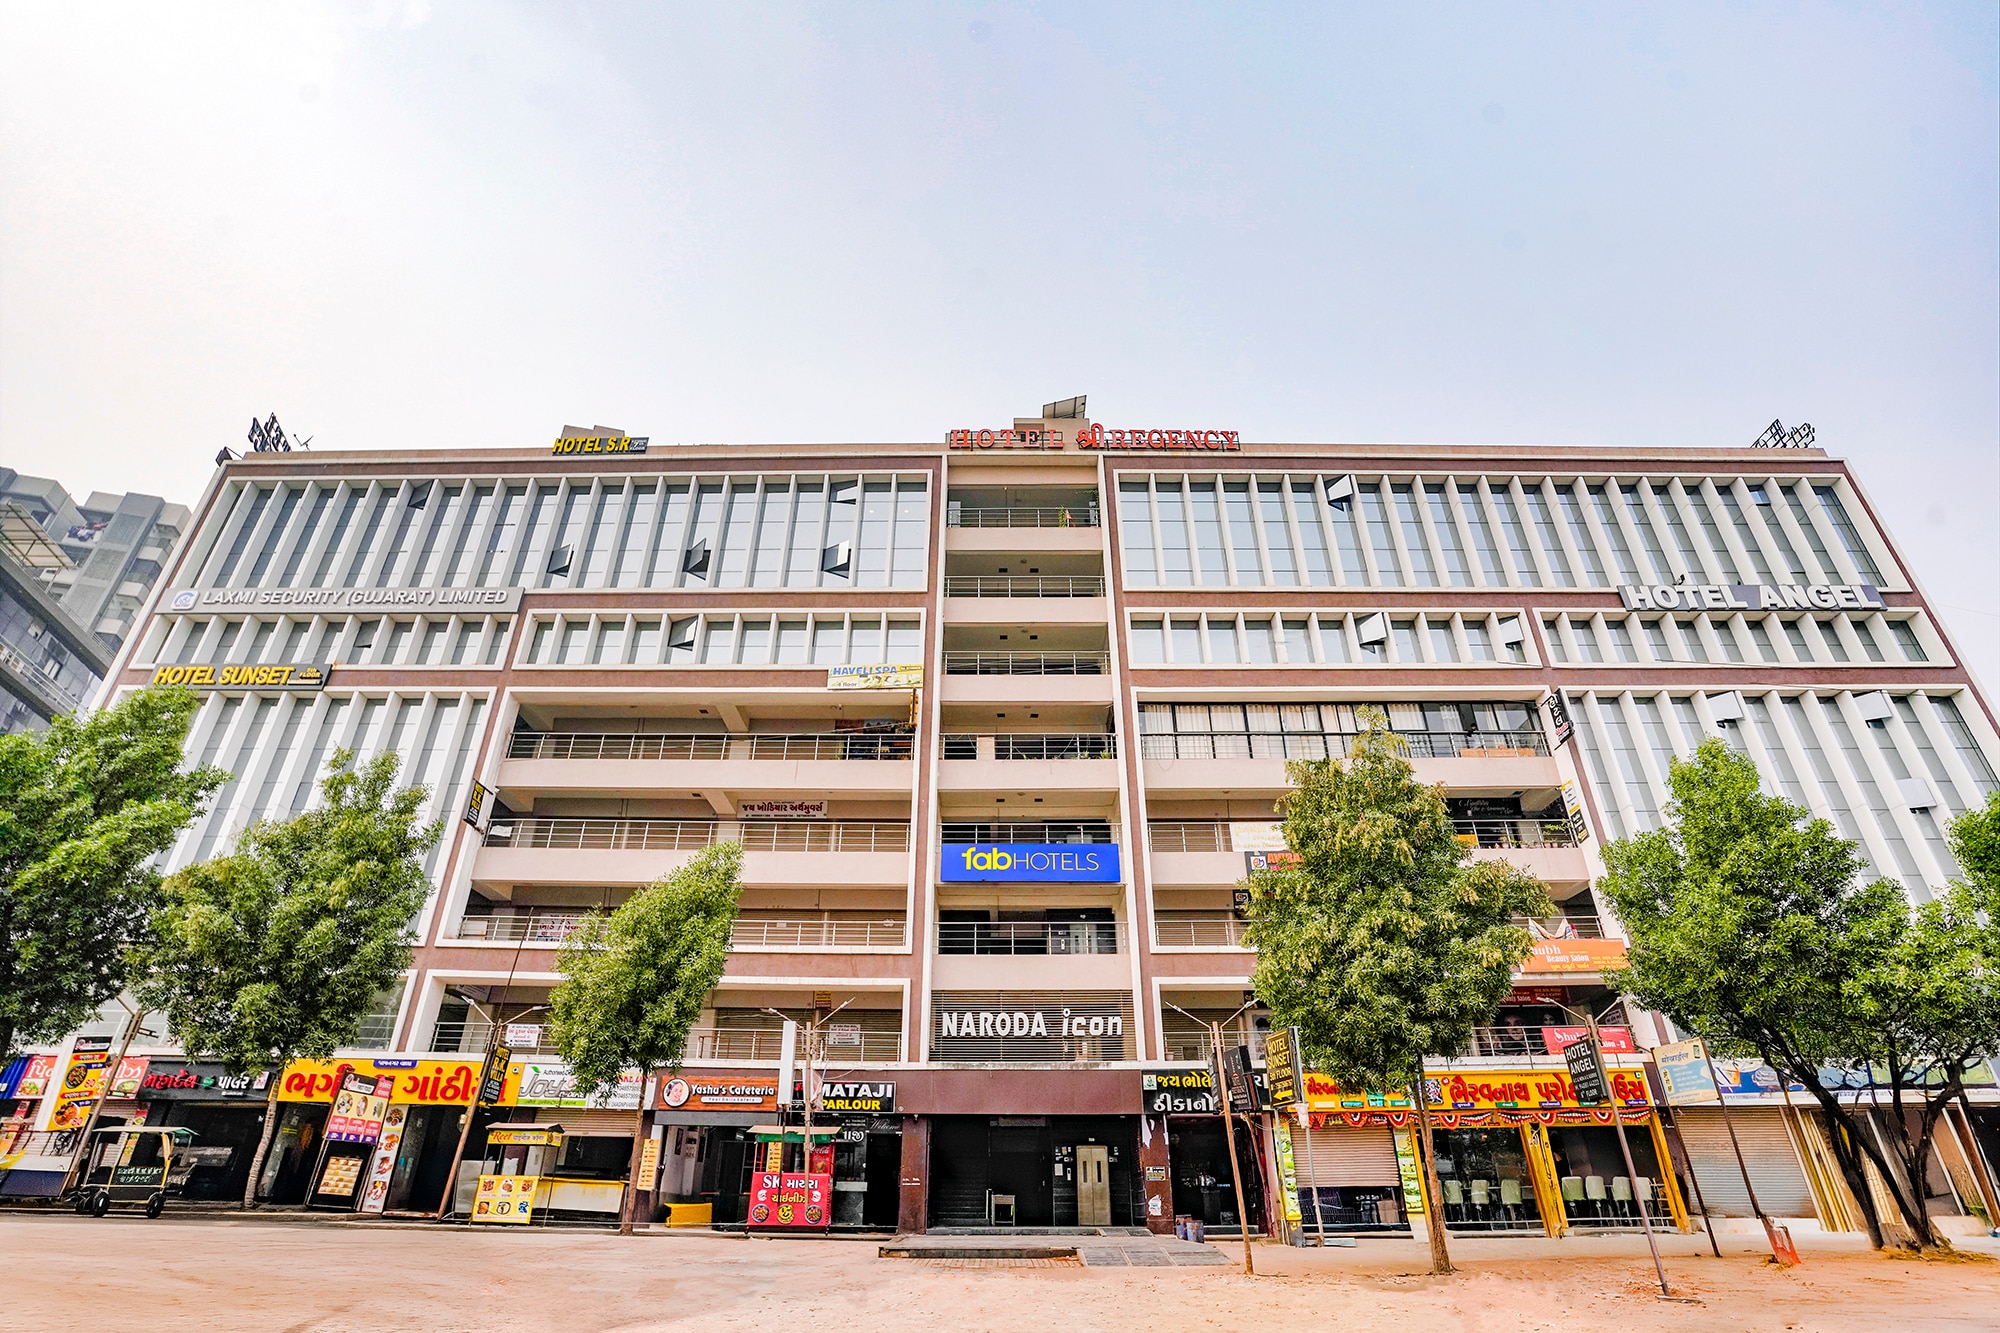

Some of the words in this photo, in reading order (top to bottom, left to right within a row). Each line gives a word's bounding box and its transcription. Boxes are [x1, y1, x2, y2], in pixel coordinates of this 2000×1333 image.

[552, 438, 602, 453] HOTEL
[605, 436, 631, 452] S.R
[950, 429, 1064, 449] HOTEL
[1110, 430, 1239, 450] REGENCY
[202, 590, 258, 605] LAXMI
[259, 590, 344, 605] SECURITY
[345, 589, 435, 606] (GUJARAT)
[438, 590, 508, 605] LIMITED
[1627, 584, 1747, 610] HOTEL
[1758, 584, 1882, 610] ANGEL
[153, 666, 216, 686] HOTEL
[218, 666, 295, 686] SUNSET
[875, 666, 897, 674] SPA
[1546, 955, 1570, 963] Beauty
[1571, 954, 1590, 962] Salon
[942, 1012, 1047, 1037] NARODA
[1062, 1008, 1122, 1037] icon
[1268, 1038, 1287, 1054] HOTEL
[1565, 1042, 1591, 1061] HOTEL
[1267, 1051, 1290, 1069] SUNSET
[1570, 1058, 1595, 1075] ANGEL
[691, 1084, 727, 1095] Yashu's
[729, 1085, 775, 1095] Cafeteria
[1156, 1074, 1181, 1088] જય
[1450, 1075, 1530, 1102] ભૈરવનાથ
[822, 1100, 881, 1110] PARLOUR
